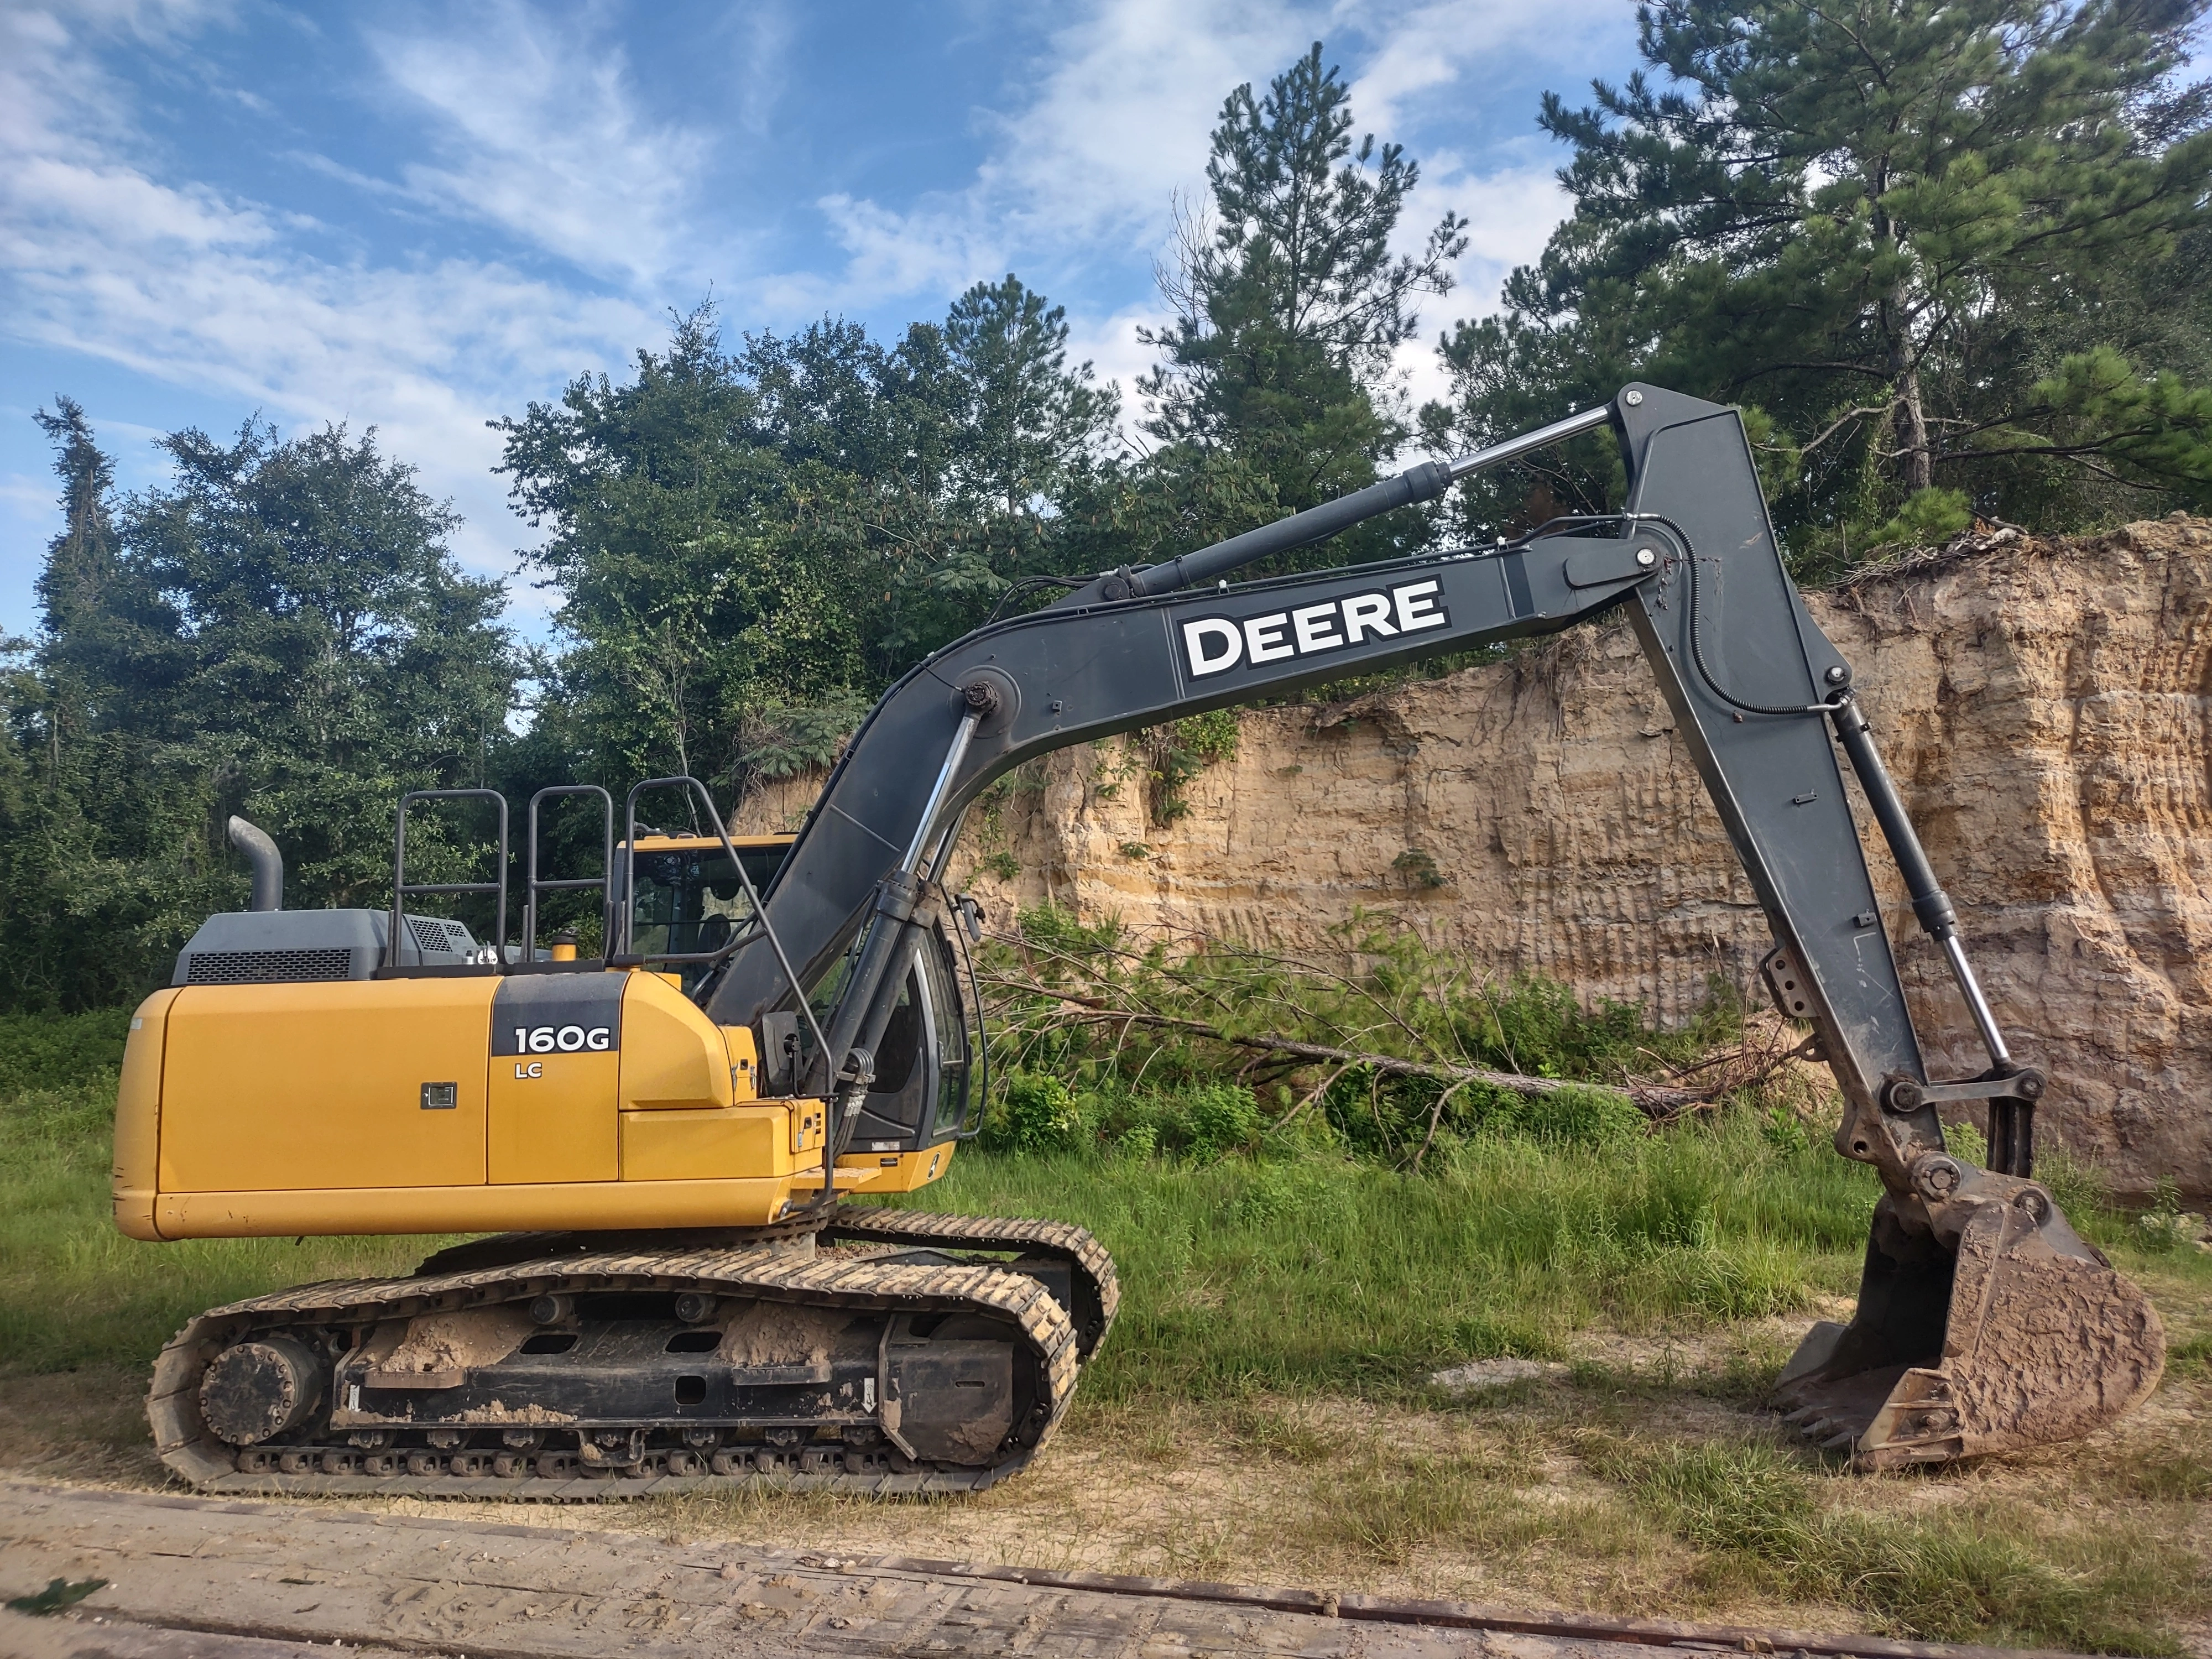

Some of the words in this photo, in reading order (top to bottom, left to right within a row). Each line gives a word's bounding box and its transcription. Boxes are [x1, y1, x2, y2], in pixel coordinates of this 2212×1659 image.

[1182, 579, 1446, 676] DEERE
[515, 1025, 610, 1053] 160G
[515, 1063, 542, 1078] LC
